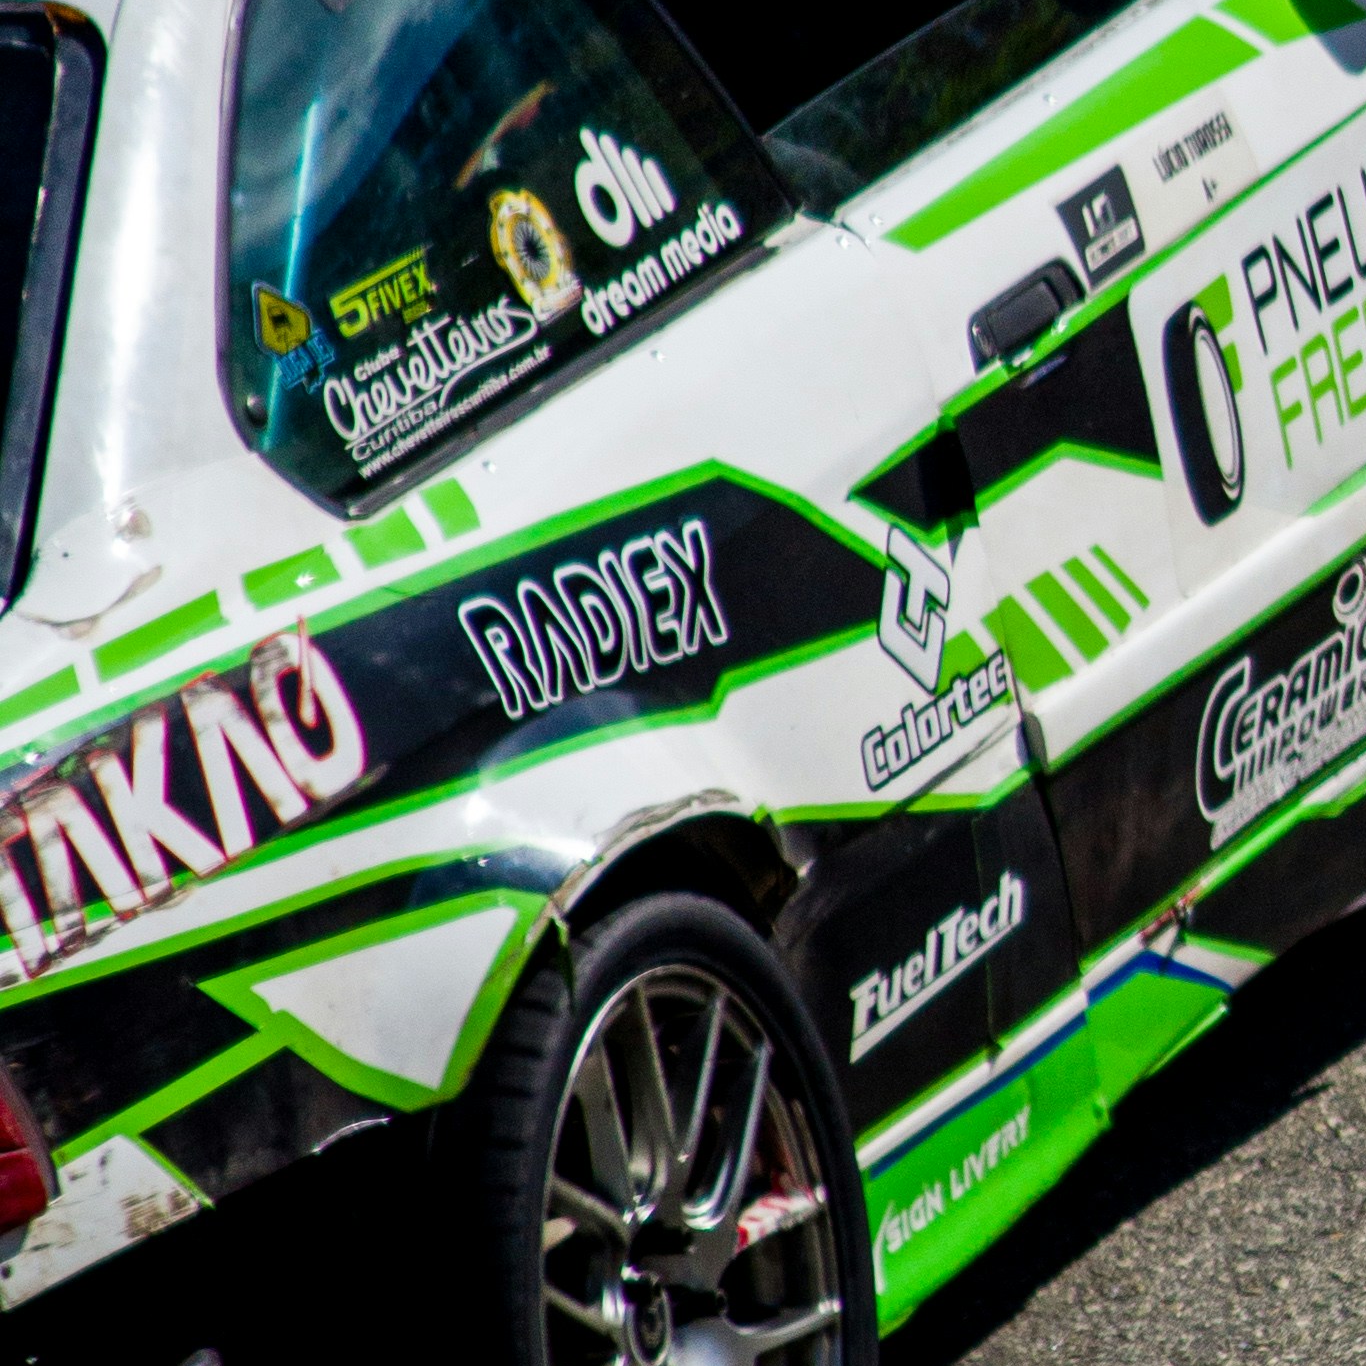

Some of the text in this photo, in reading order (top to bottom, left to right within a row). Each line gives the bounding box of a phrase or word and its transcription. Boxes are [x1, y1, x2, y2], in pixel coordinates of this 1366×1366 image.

[581, 255, 668, 336] dream
[661, 201, 743, 282] media
[458, 520, 728, 720] RADIEX
[861, 647, 1009, 792] Colortec
[849, 869, 1026, 1040] FuelTech
